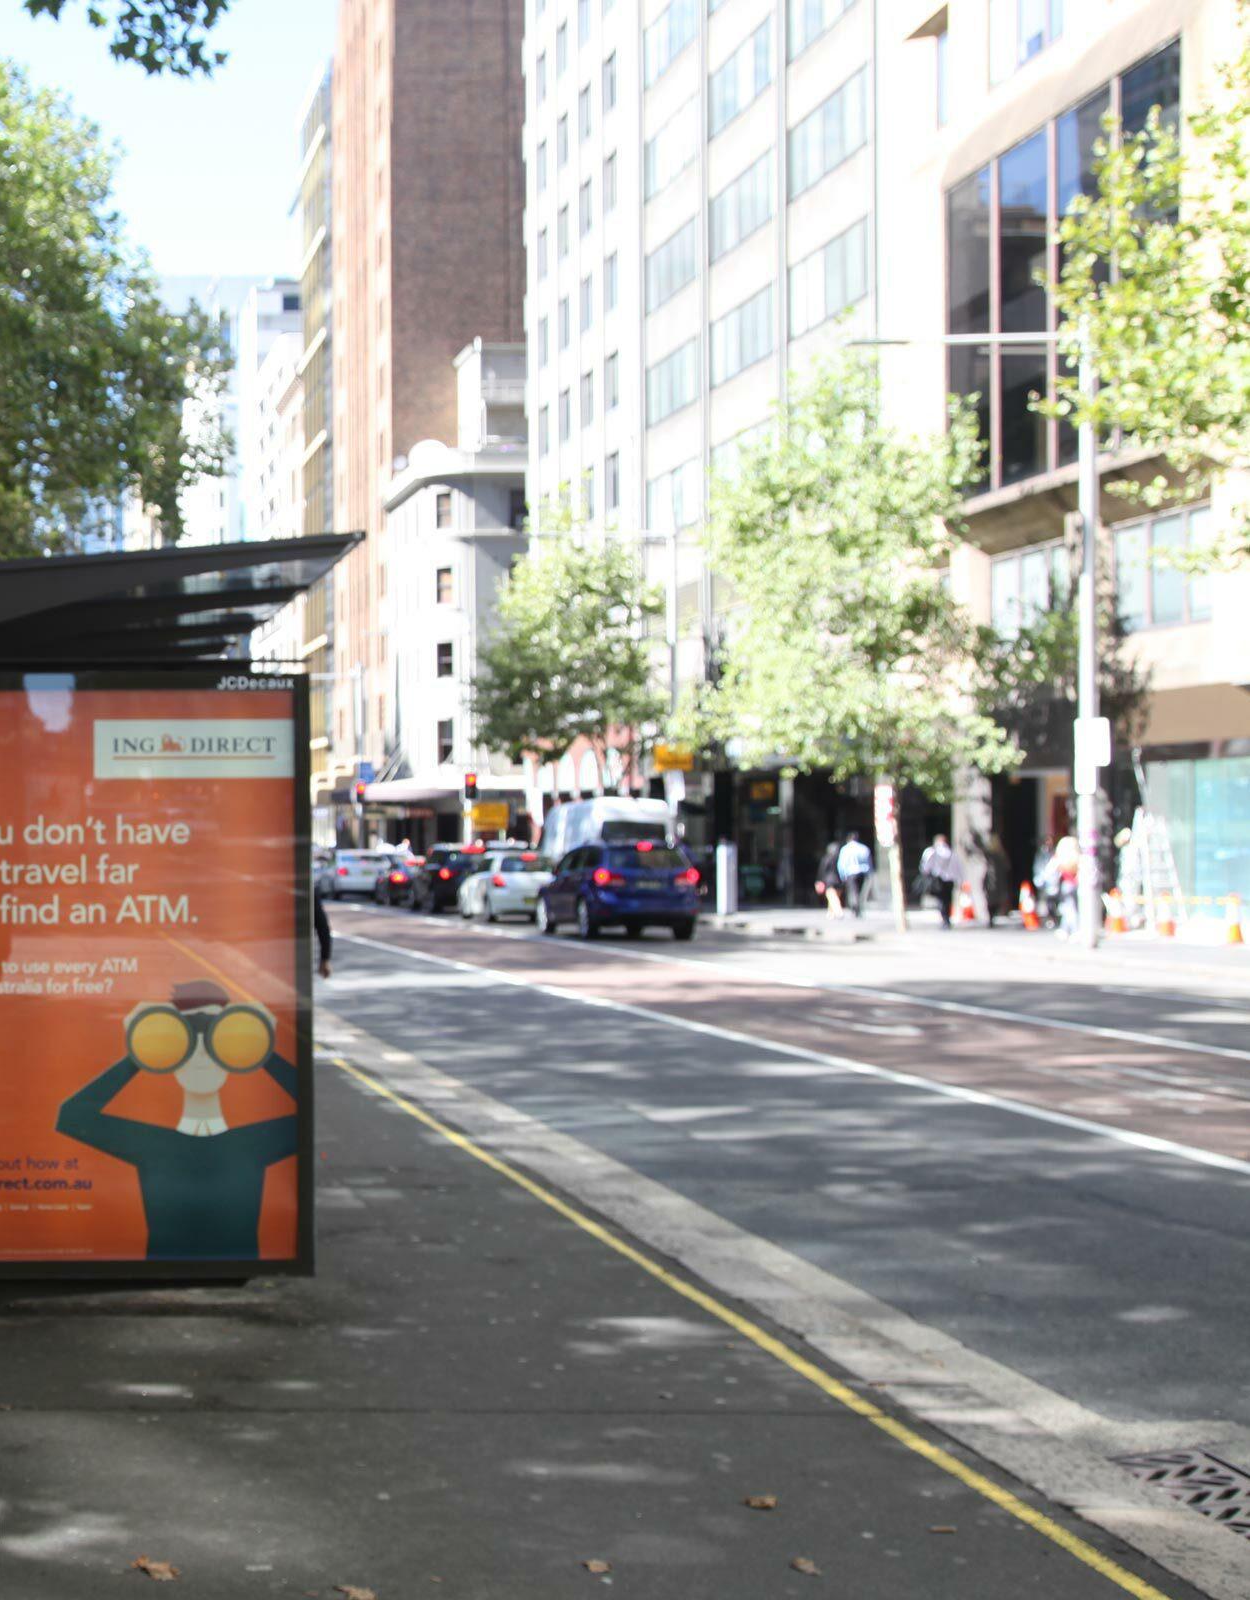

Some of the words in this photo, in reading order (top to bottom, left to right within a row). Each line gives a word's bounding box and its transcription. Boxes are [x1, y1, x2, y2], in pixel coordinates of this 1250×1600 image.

[217, 676, 294, 690] JCDecaux
[113, 737, 154, 753] ING
[191, 736, 276, 753] DIRECT
[23, 815, 106, 845] don't
[116, 814, 191, 845] have
[96, 853, 140, 884] far
[69, 902, 106, 924] an
[116, 894, 198, 924] ATM.
[1, 960, 18, 974] to
[22, 963, 50, 974] use
[53, 963, 97, 978] every
[101, 958, 138, 974] ATM
[46, 977, 68, 994] for
[73, 977, 114, 994] free?
[26, 1156, 58, 1171] how
[64, 1158, 78, 1170] at
